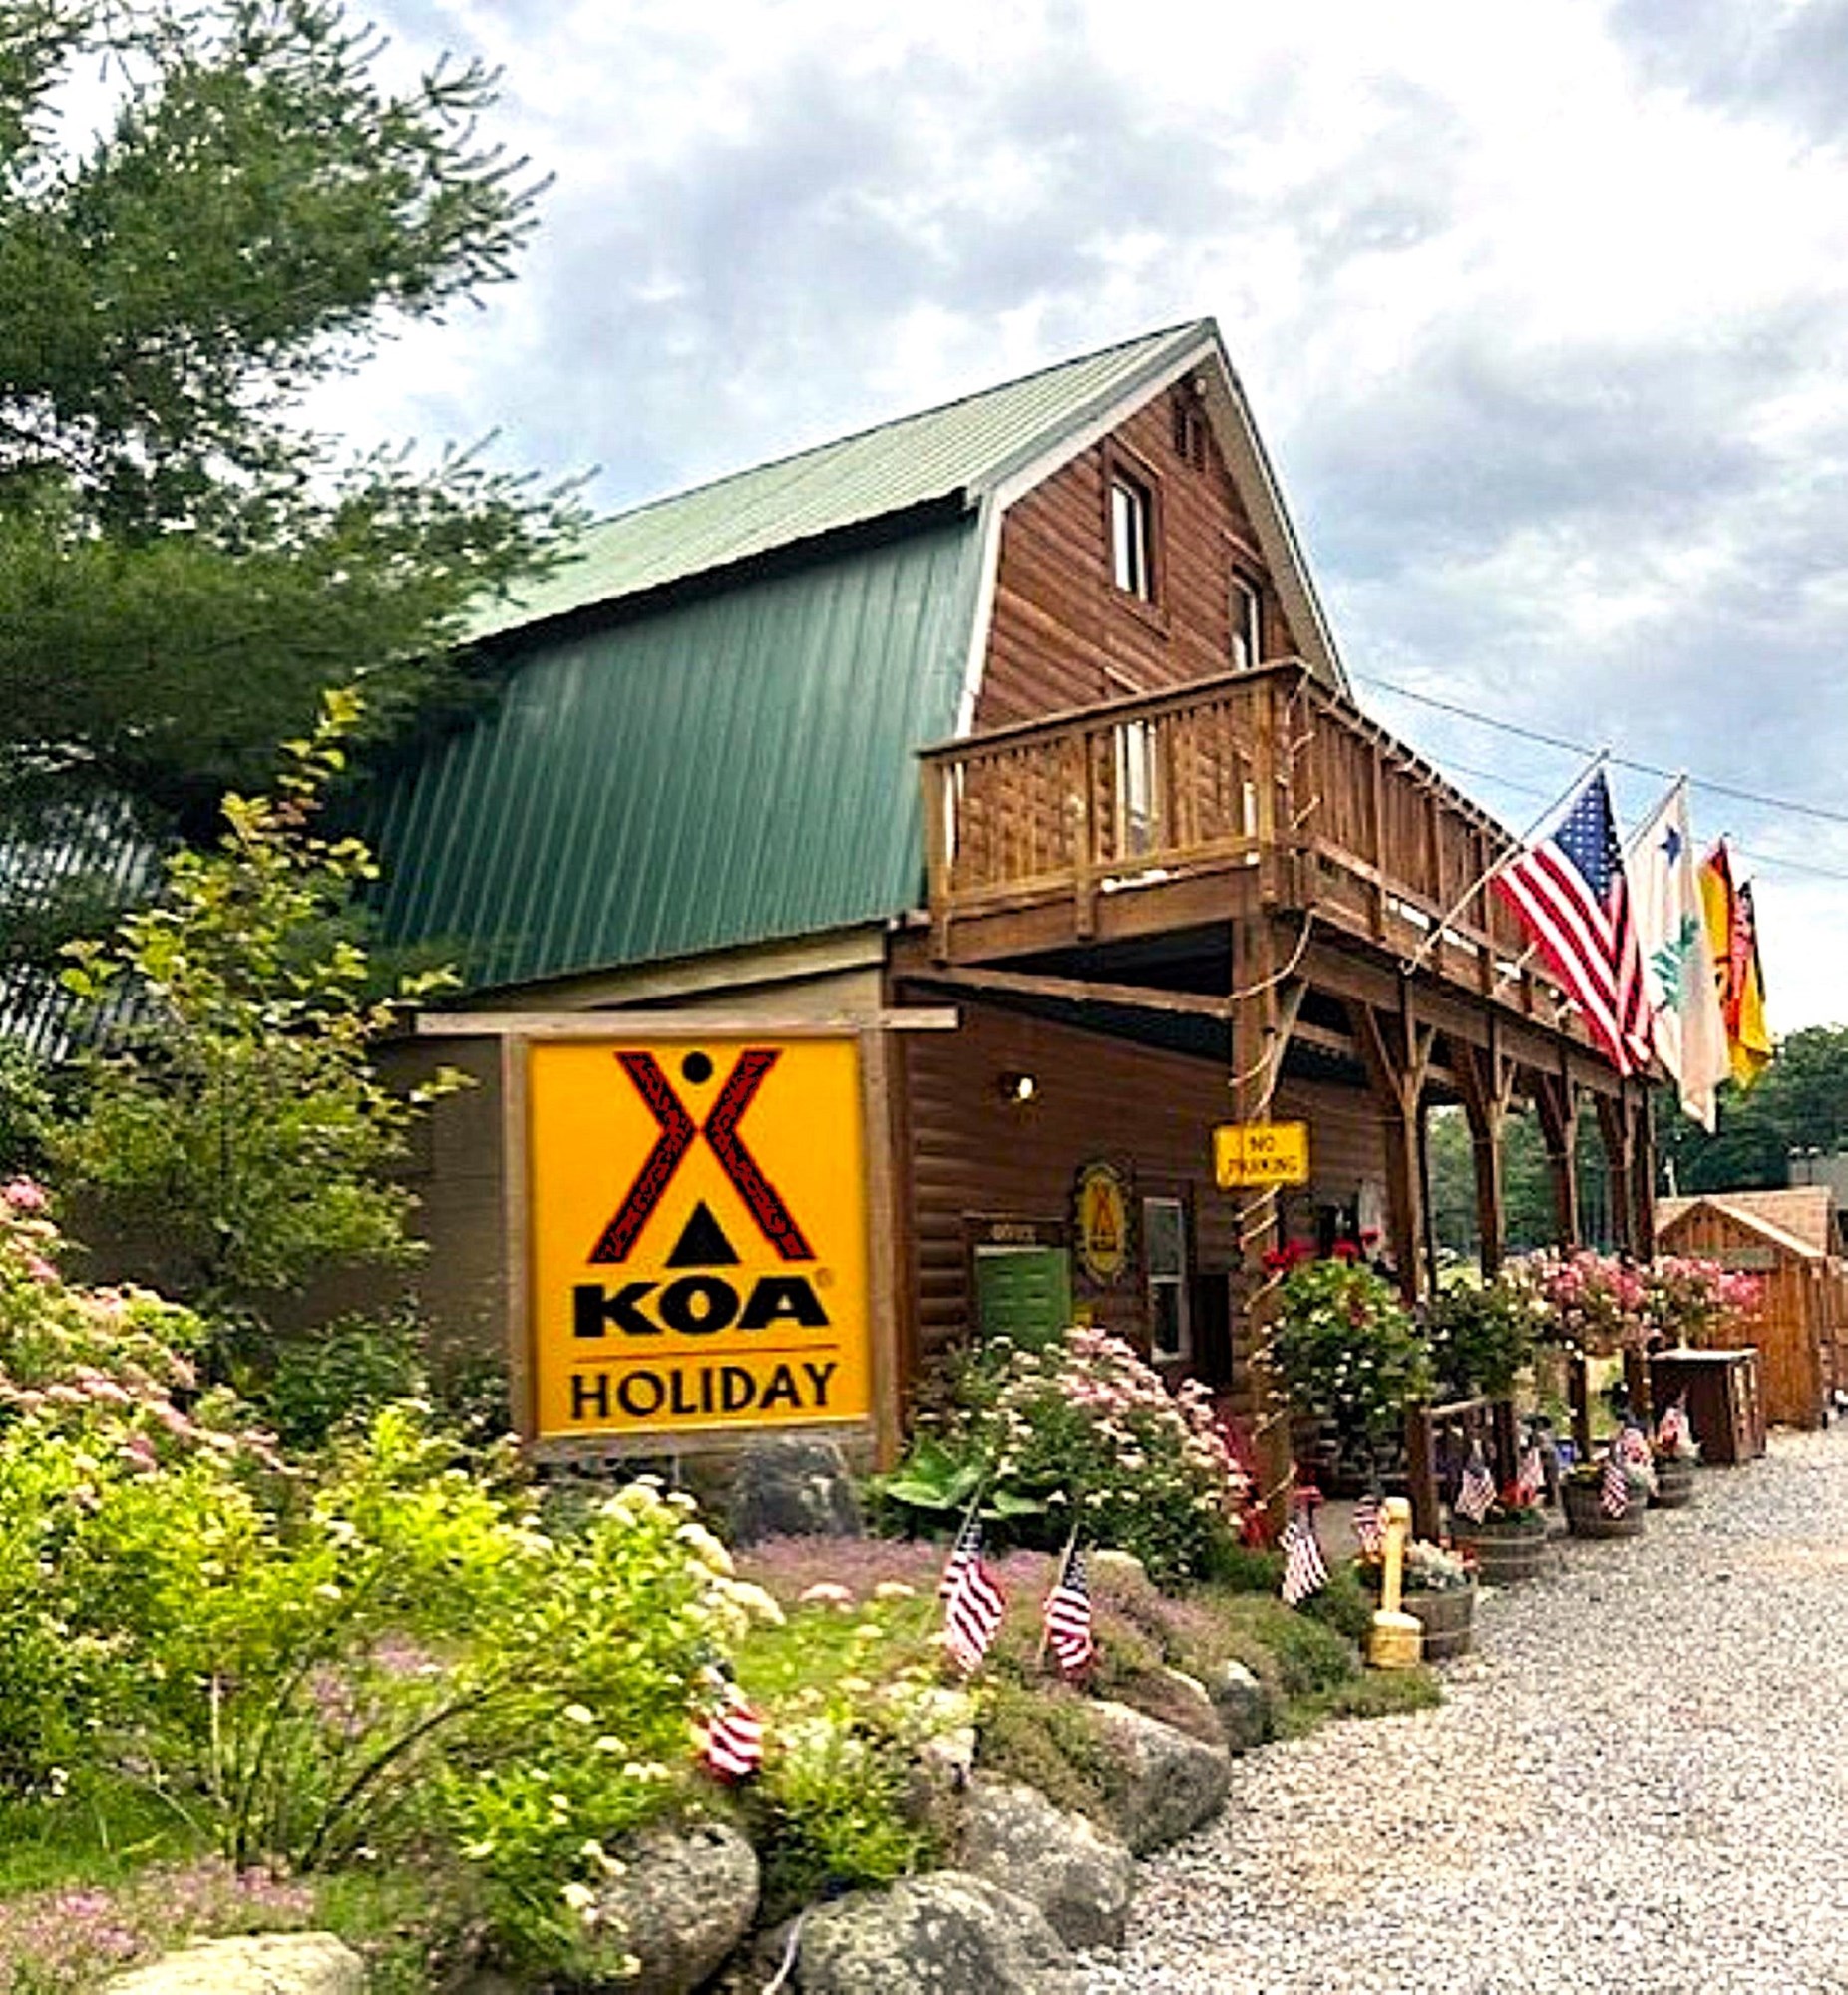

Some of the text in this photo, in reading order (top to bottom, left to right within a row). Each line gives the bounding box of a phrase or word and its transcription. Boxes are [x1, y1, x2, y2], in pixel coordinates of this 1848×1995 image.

[1249, 1134, 1275, 1153] NO
[572, 1275, 830, 1338] KOA
[570, 1362, 837, 1420] HOLIDAY
